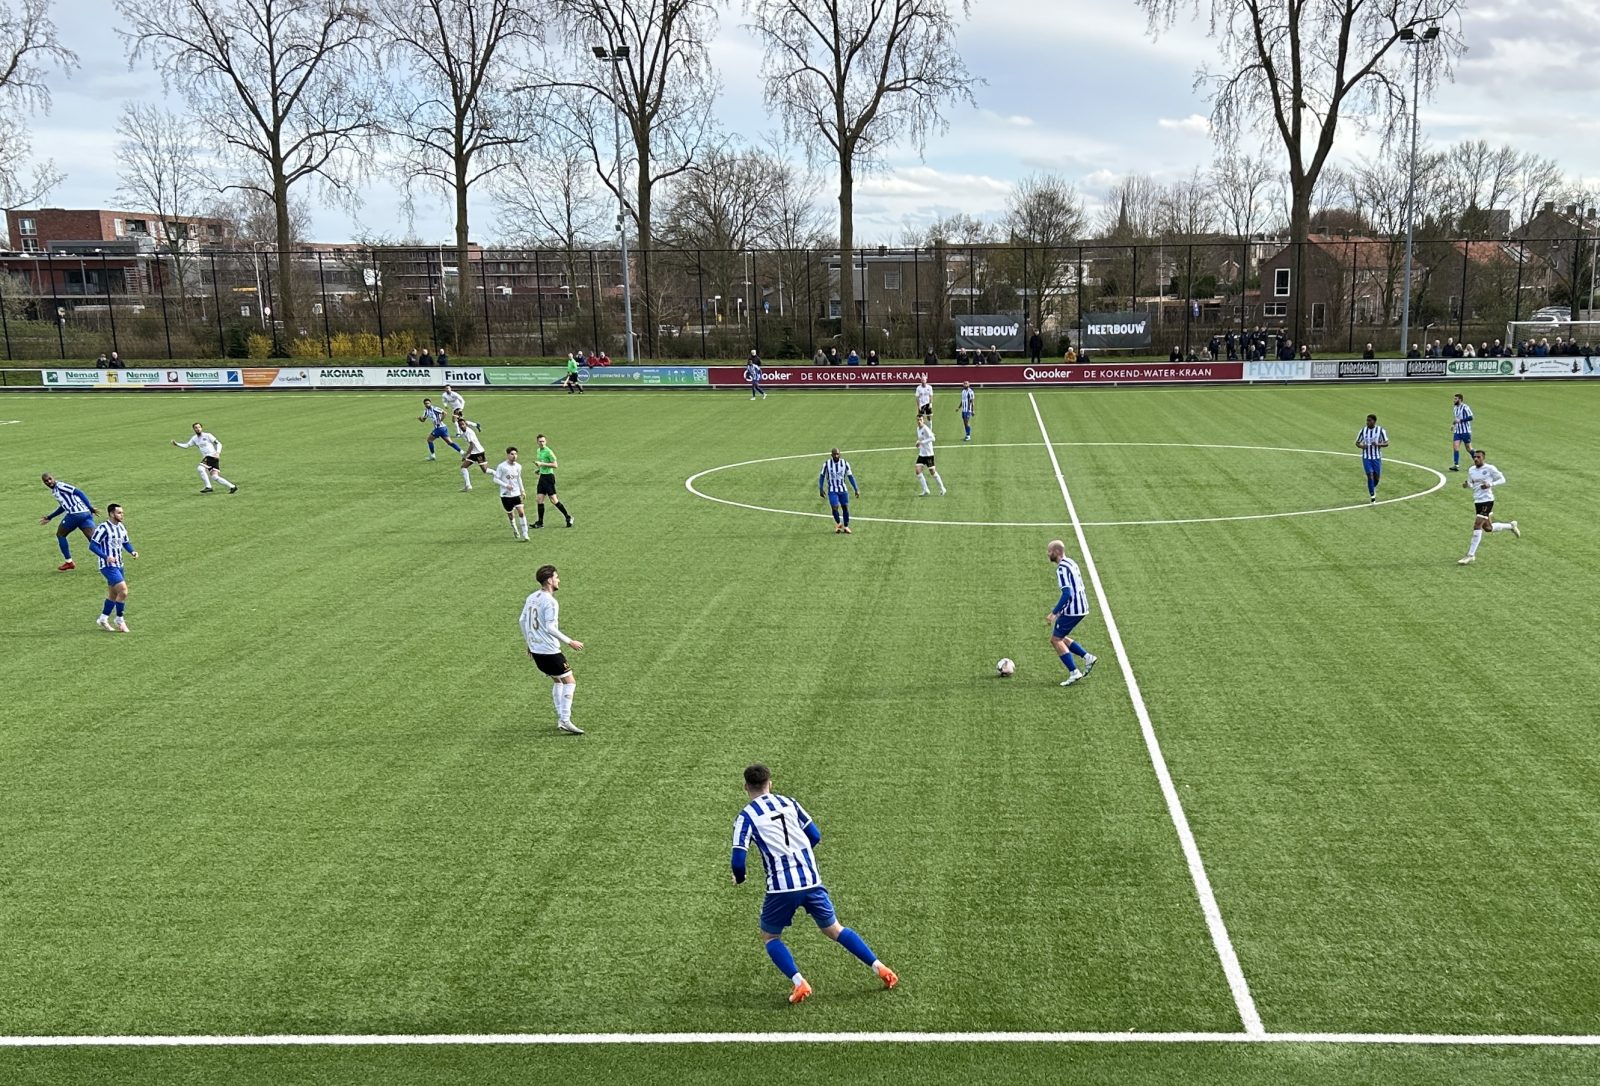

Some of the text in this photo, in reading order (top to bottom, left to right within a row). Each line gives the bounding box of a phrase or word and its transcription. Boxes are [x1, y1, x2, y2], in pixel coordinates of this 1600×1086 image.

[960, 325, 1017, 336] MEERBOUW
[1088, 323, 1144, 335] MEERBOUW
[1249, 362, 1306, 376] FLYNTH
[1455, 361, 1473, 370] VERS
[320, 369, 364, 378] AKOMAR
[386, 369, 431, 378] AKOMAR
[445, 371, 482, 381] Fintor
[743, 369, 791, 382] Qooker
[801, 372, 929, 381] DE KOKEND-WATER-KRAAN
[1023, 367, 1071, 381] Quooker
[1084, 368, 1212, 378] DE KOKEND-WATER-KRAAN
[528, 606, 540, 631] 13
[771, 813, 790, 847] 7
